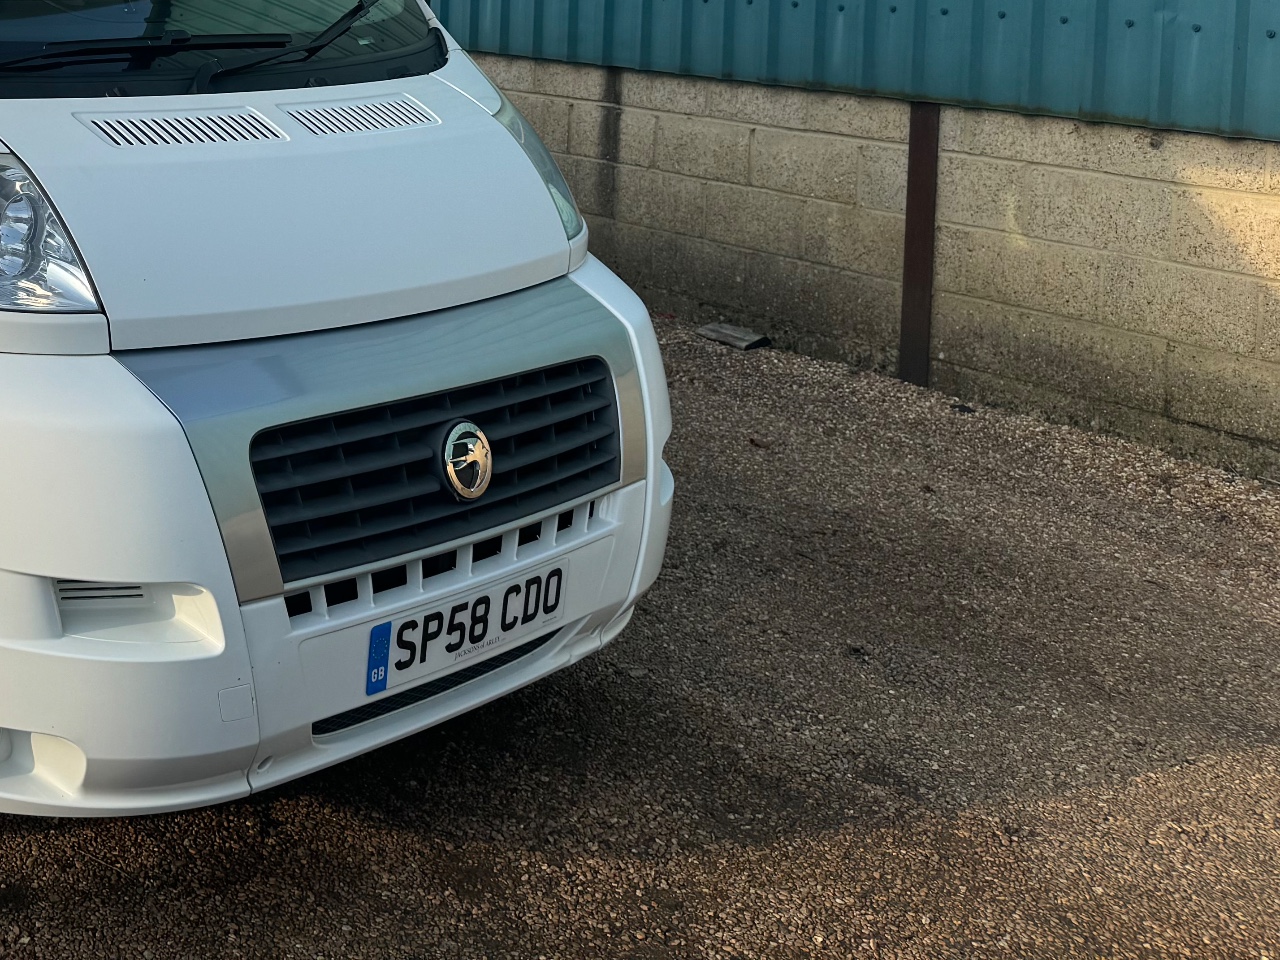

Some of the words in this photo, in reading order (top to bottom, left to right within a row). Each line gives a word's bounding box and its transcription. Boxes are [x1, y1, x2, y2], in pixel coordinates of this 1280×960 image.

[394, 594, 490, 671] SP58
[500, 567, 563, 633] CDO
[371, 666, 385, 683] GB
